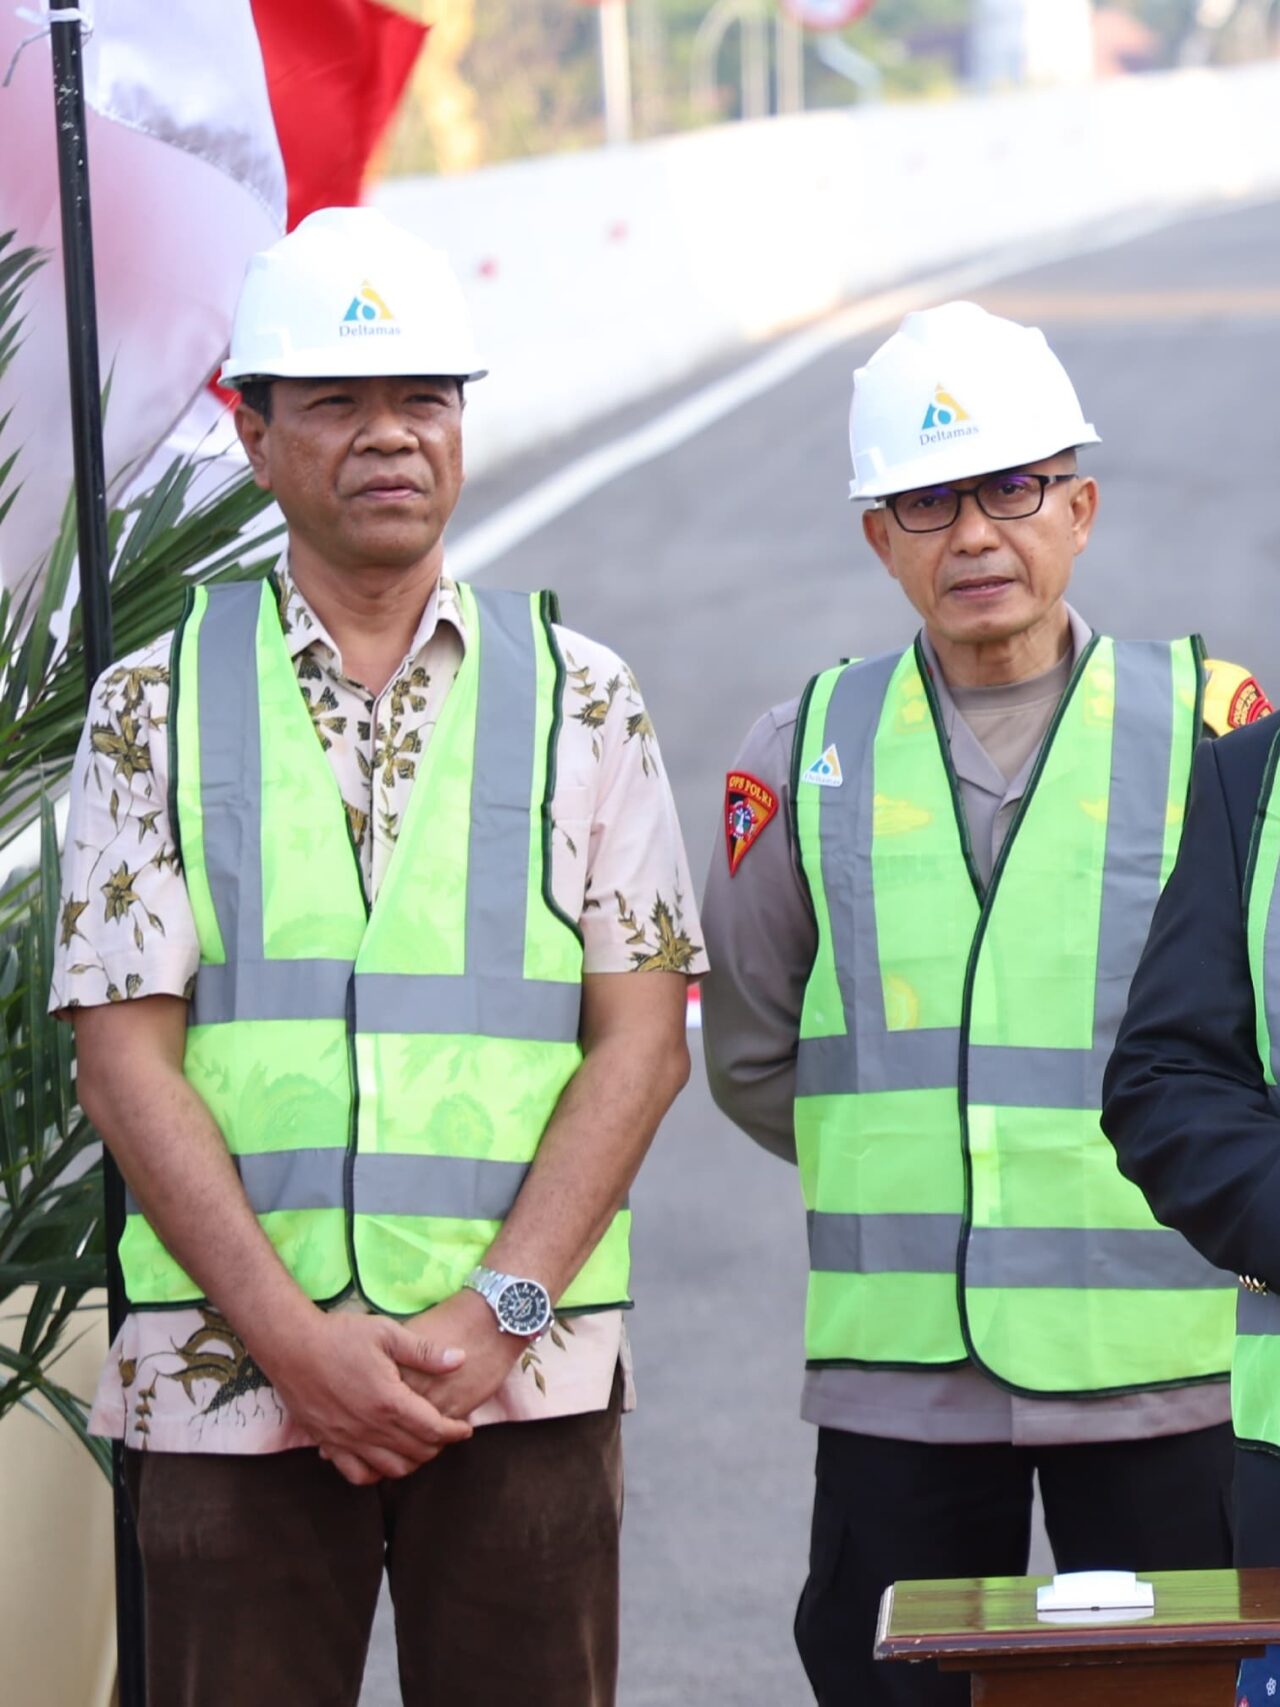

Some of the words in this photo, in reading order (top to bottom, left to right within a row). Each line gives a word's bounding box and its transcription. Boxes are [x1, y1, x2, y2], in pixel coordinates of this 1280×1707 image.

[339, 324, 402, 337] Deltamas
[919, 426, 979, 446] Deltamas
[744, 779, 773, 808] POLRI
